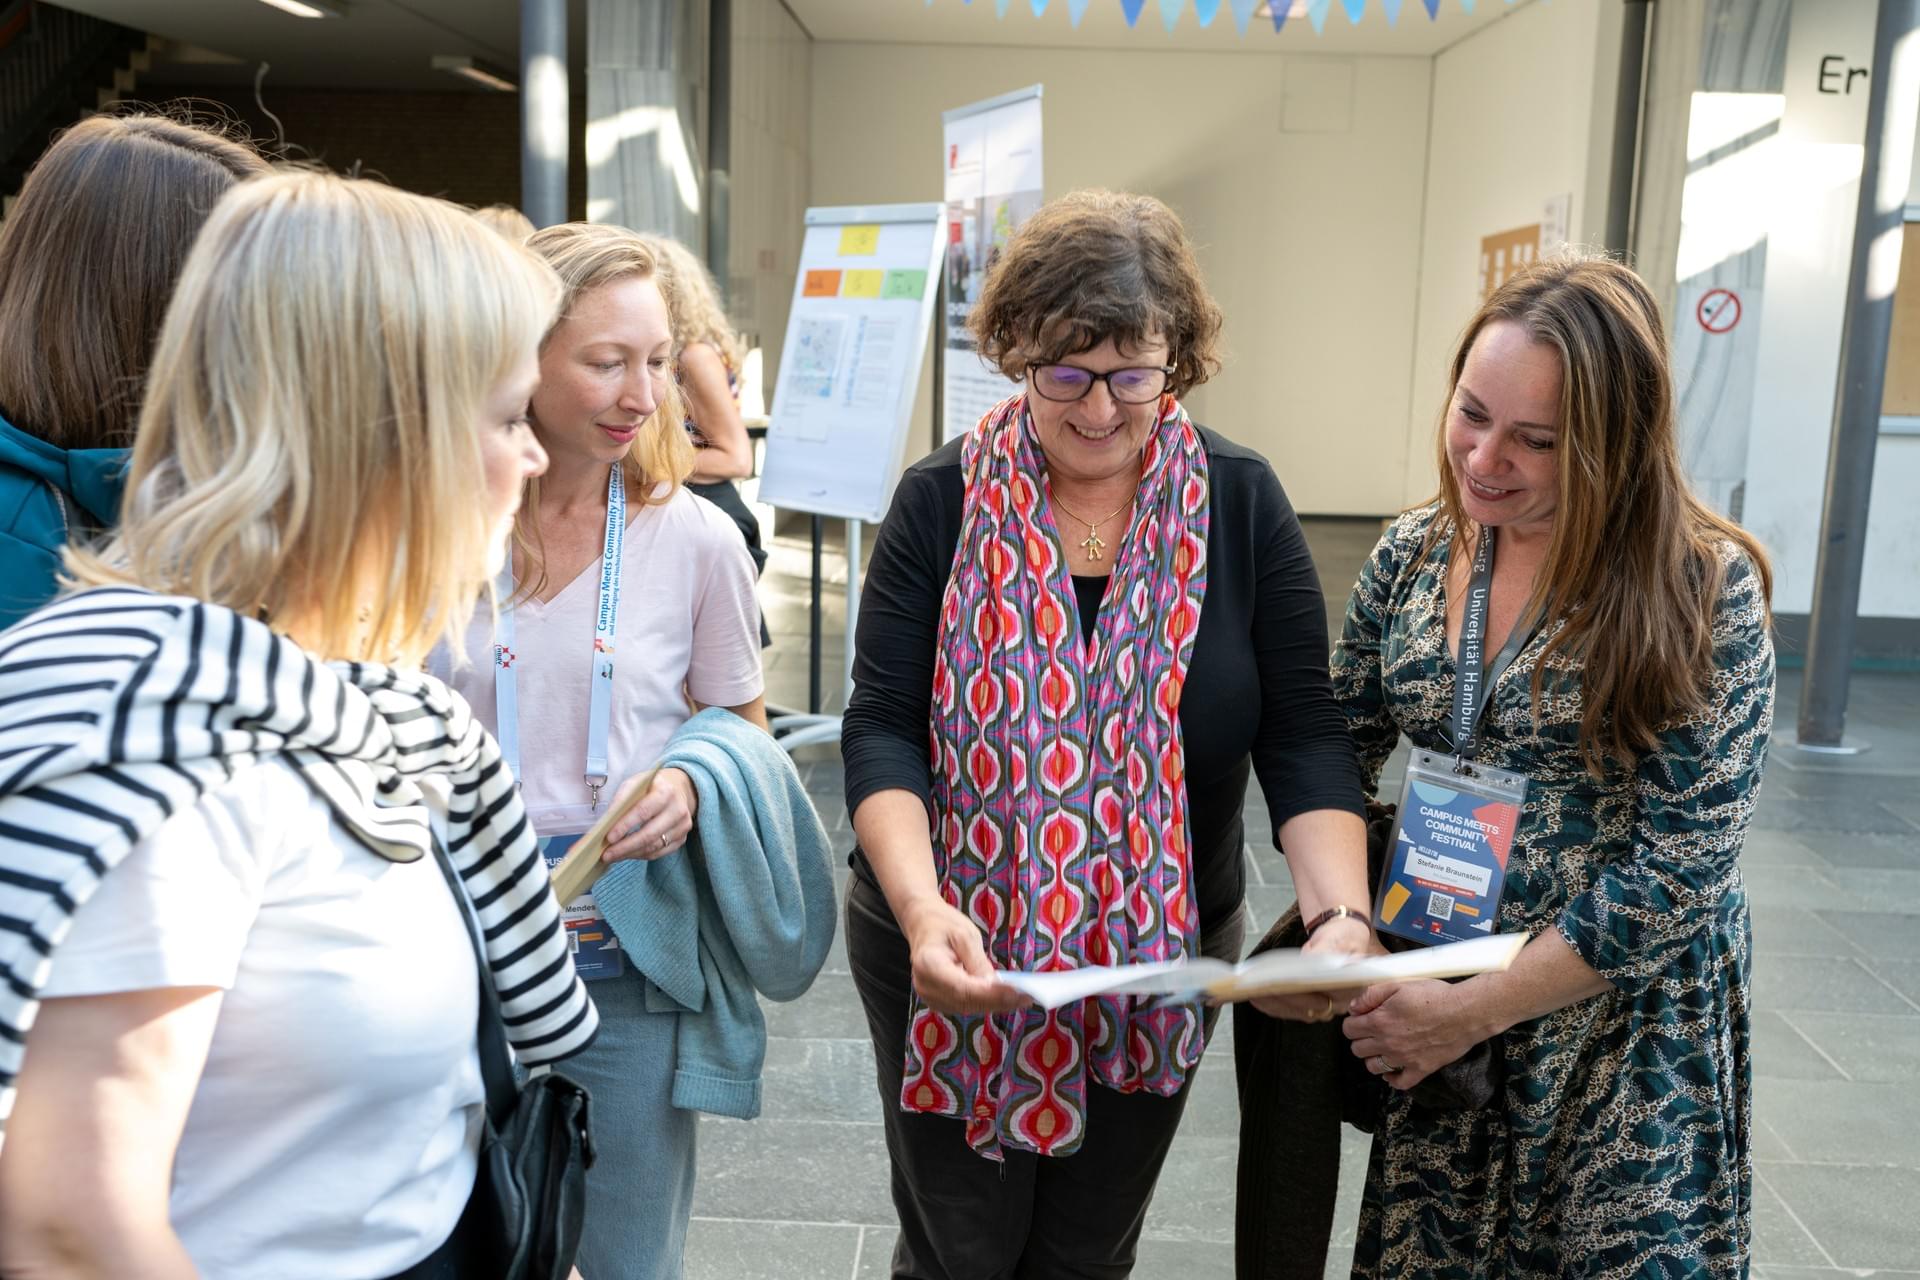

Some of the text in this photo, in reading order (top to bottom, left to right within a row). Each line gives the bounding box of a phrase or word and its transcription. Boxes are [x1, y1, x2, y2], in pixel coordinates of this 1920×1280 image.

[1818, 55, 1868, 95] Er
[604, 504, 620, 560] Community
[601, 562, 613, 592] Meets
[597, 593, 611, 631] Campus
[1465, 588, 1486, 666] Universität
[1457, 672, 1478, 742] Hamburg
[1420, 806, 1500, 835] CAMPUS MEETS
[1425, 819, 1489, 843] COMMUNITY
[1430, 831, 1477, 852] FESTIVAL
[1417, 858, 1445, 872] Stefanie
[1445, 866, 1483, 882] Braunstein
[565, 904, 596, 914] Mendes
